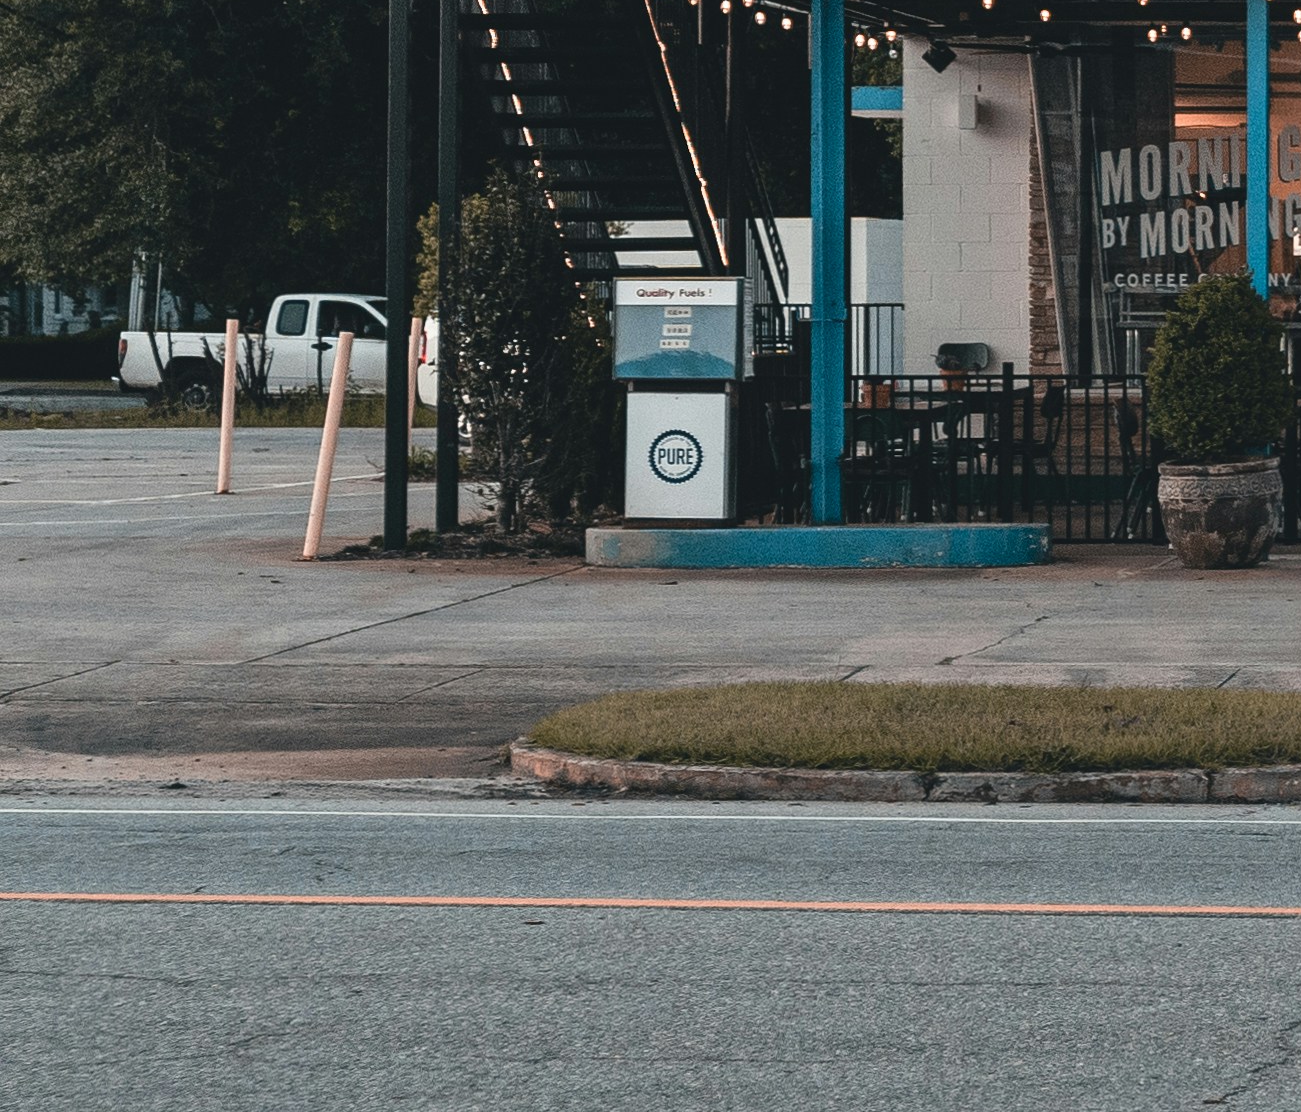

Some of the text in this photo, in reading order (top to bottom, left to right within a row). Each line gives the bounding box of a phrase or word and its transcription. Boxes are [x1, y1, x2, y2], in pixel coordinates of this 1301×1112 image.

[1102, 215, 1130, 249] BY
[1114, 272, 1189, 288] COFFEE
[636, 288, 675, 300] Quality
[679, 288, 705, 297] Fuels
[658, 448, 693, 465] PURE
